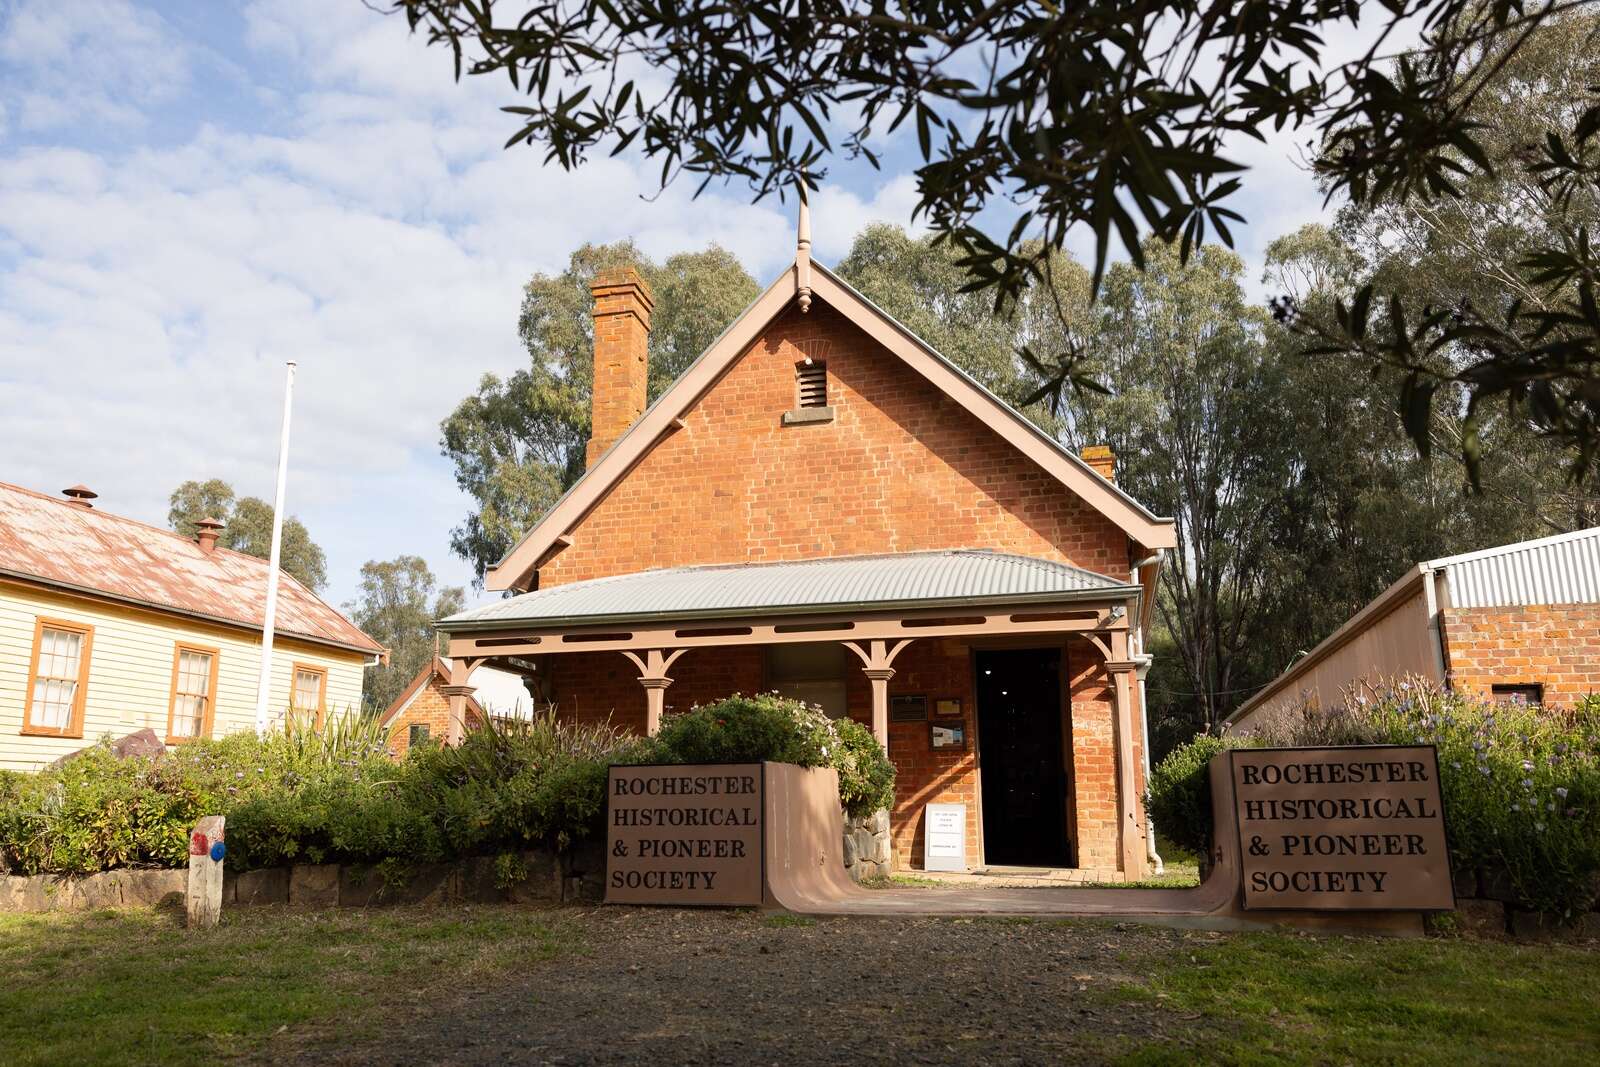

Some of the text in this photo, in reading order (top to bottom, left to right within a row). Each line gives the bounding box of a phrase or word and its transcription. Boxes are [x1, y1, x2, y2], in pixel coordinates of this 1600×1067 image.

[1241, 762, 1428, 784] ROCHESTER
[614, 777, 755, 795] ROCHESTER
[613, 808, 757, 826] HISTORICAL
[1244, 799, 1436, 820] HISTORICAL
[612, 840, 746, 858] & PIONEER
[1248, 835, 1427, 856] & PIONEER
[611, 871, 717, 889] SOCIETY
[1252, 872, 1387, 892] SOCIETY
